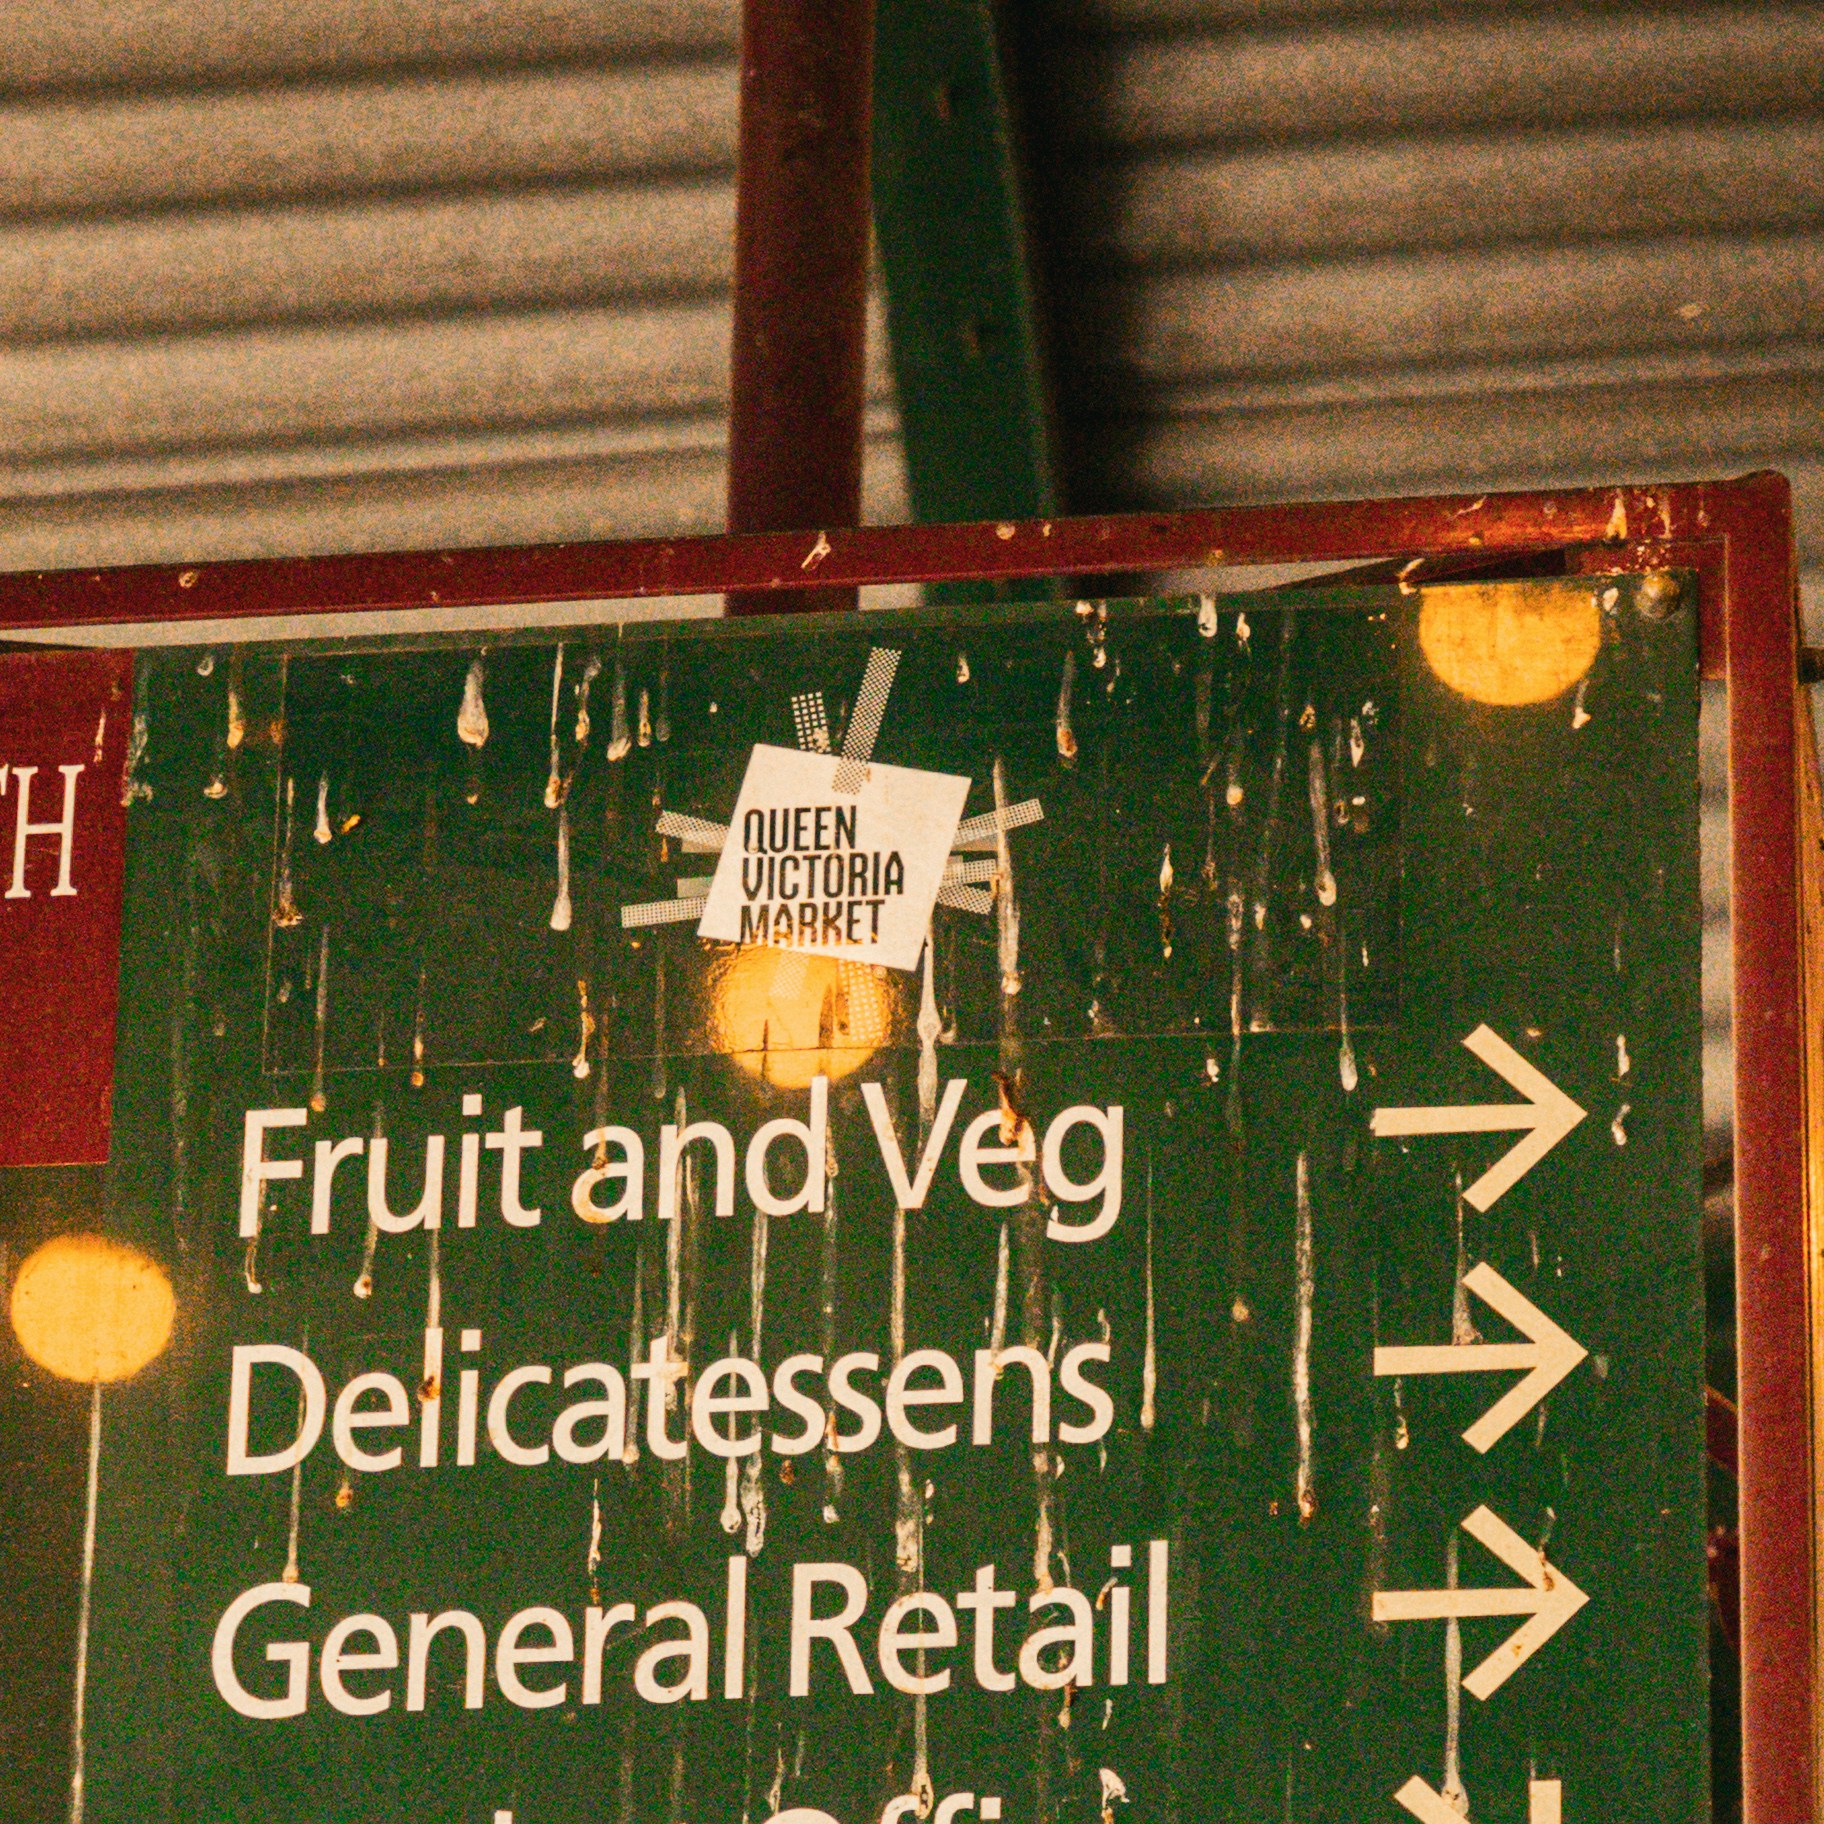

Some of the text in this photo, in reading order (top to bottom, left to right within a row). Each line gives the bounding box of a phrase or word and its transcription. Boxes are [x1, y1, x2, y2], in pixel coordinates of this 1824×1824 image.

[740, 850, 906, 900] VICTORIA
[742, 804, 858, 856] QUEEN
[739, 899, 886, 946] MARKET
[238, 1075, 1126, 1243] Fruit and Veg
[225, 1326, 1113, 1476] Delicatessens
[210, 1539, 1169, 1720] General Retail
